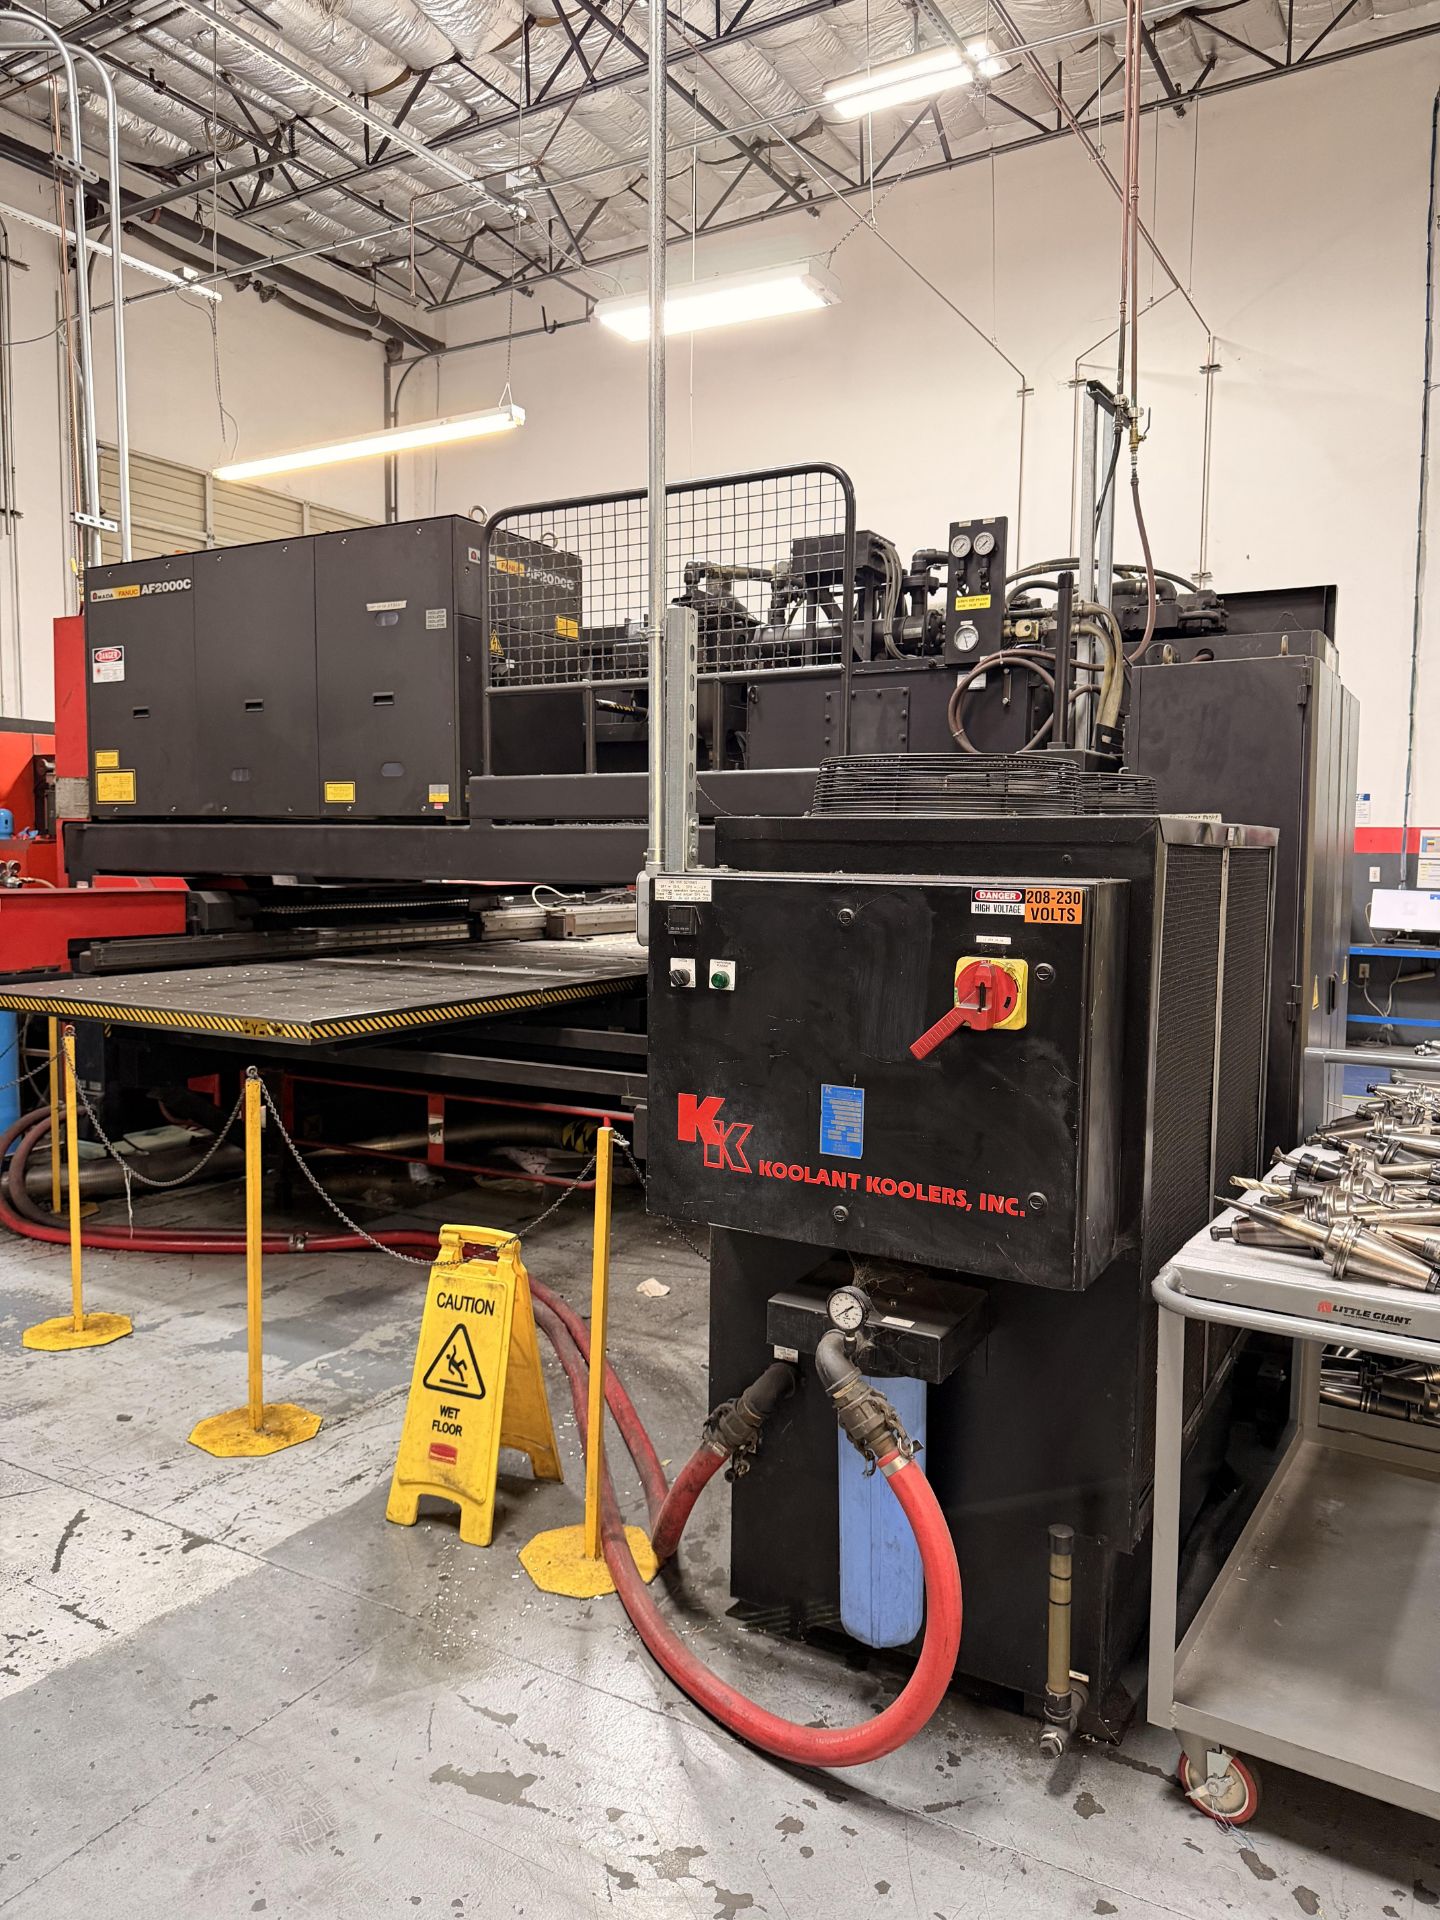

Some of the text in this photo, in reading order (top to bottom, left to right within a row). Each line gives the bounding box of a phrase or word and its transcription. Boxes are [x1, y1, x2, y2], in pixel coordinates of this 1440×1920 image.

[118, 588, 139, 597] FANUC
[141, 578, 192, 595] AF2000C
[99, 651, 118, 660] DANGER
[980, 892, 1017, 900] DANGER
[1026, 890, 1081, 905] 208-230
[975, 903, 1021, 914] HIGH VOLTAGE
[1031, 907, 1076, 922] VOLTS
[758, 1159, 1026, 1217] KOOLANT KOOLERS, INC.
[436, 1292, 496, 1316] CAUTION
[1332, 1304, 1372, 1318] LITTLE
[1372, 1311, 1412, 1325] GIANT
[439, 1404, 461, 1420] WET
[431, 1419, 463, 1437] FLOOR
